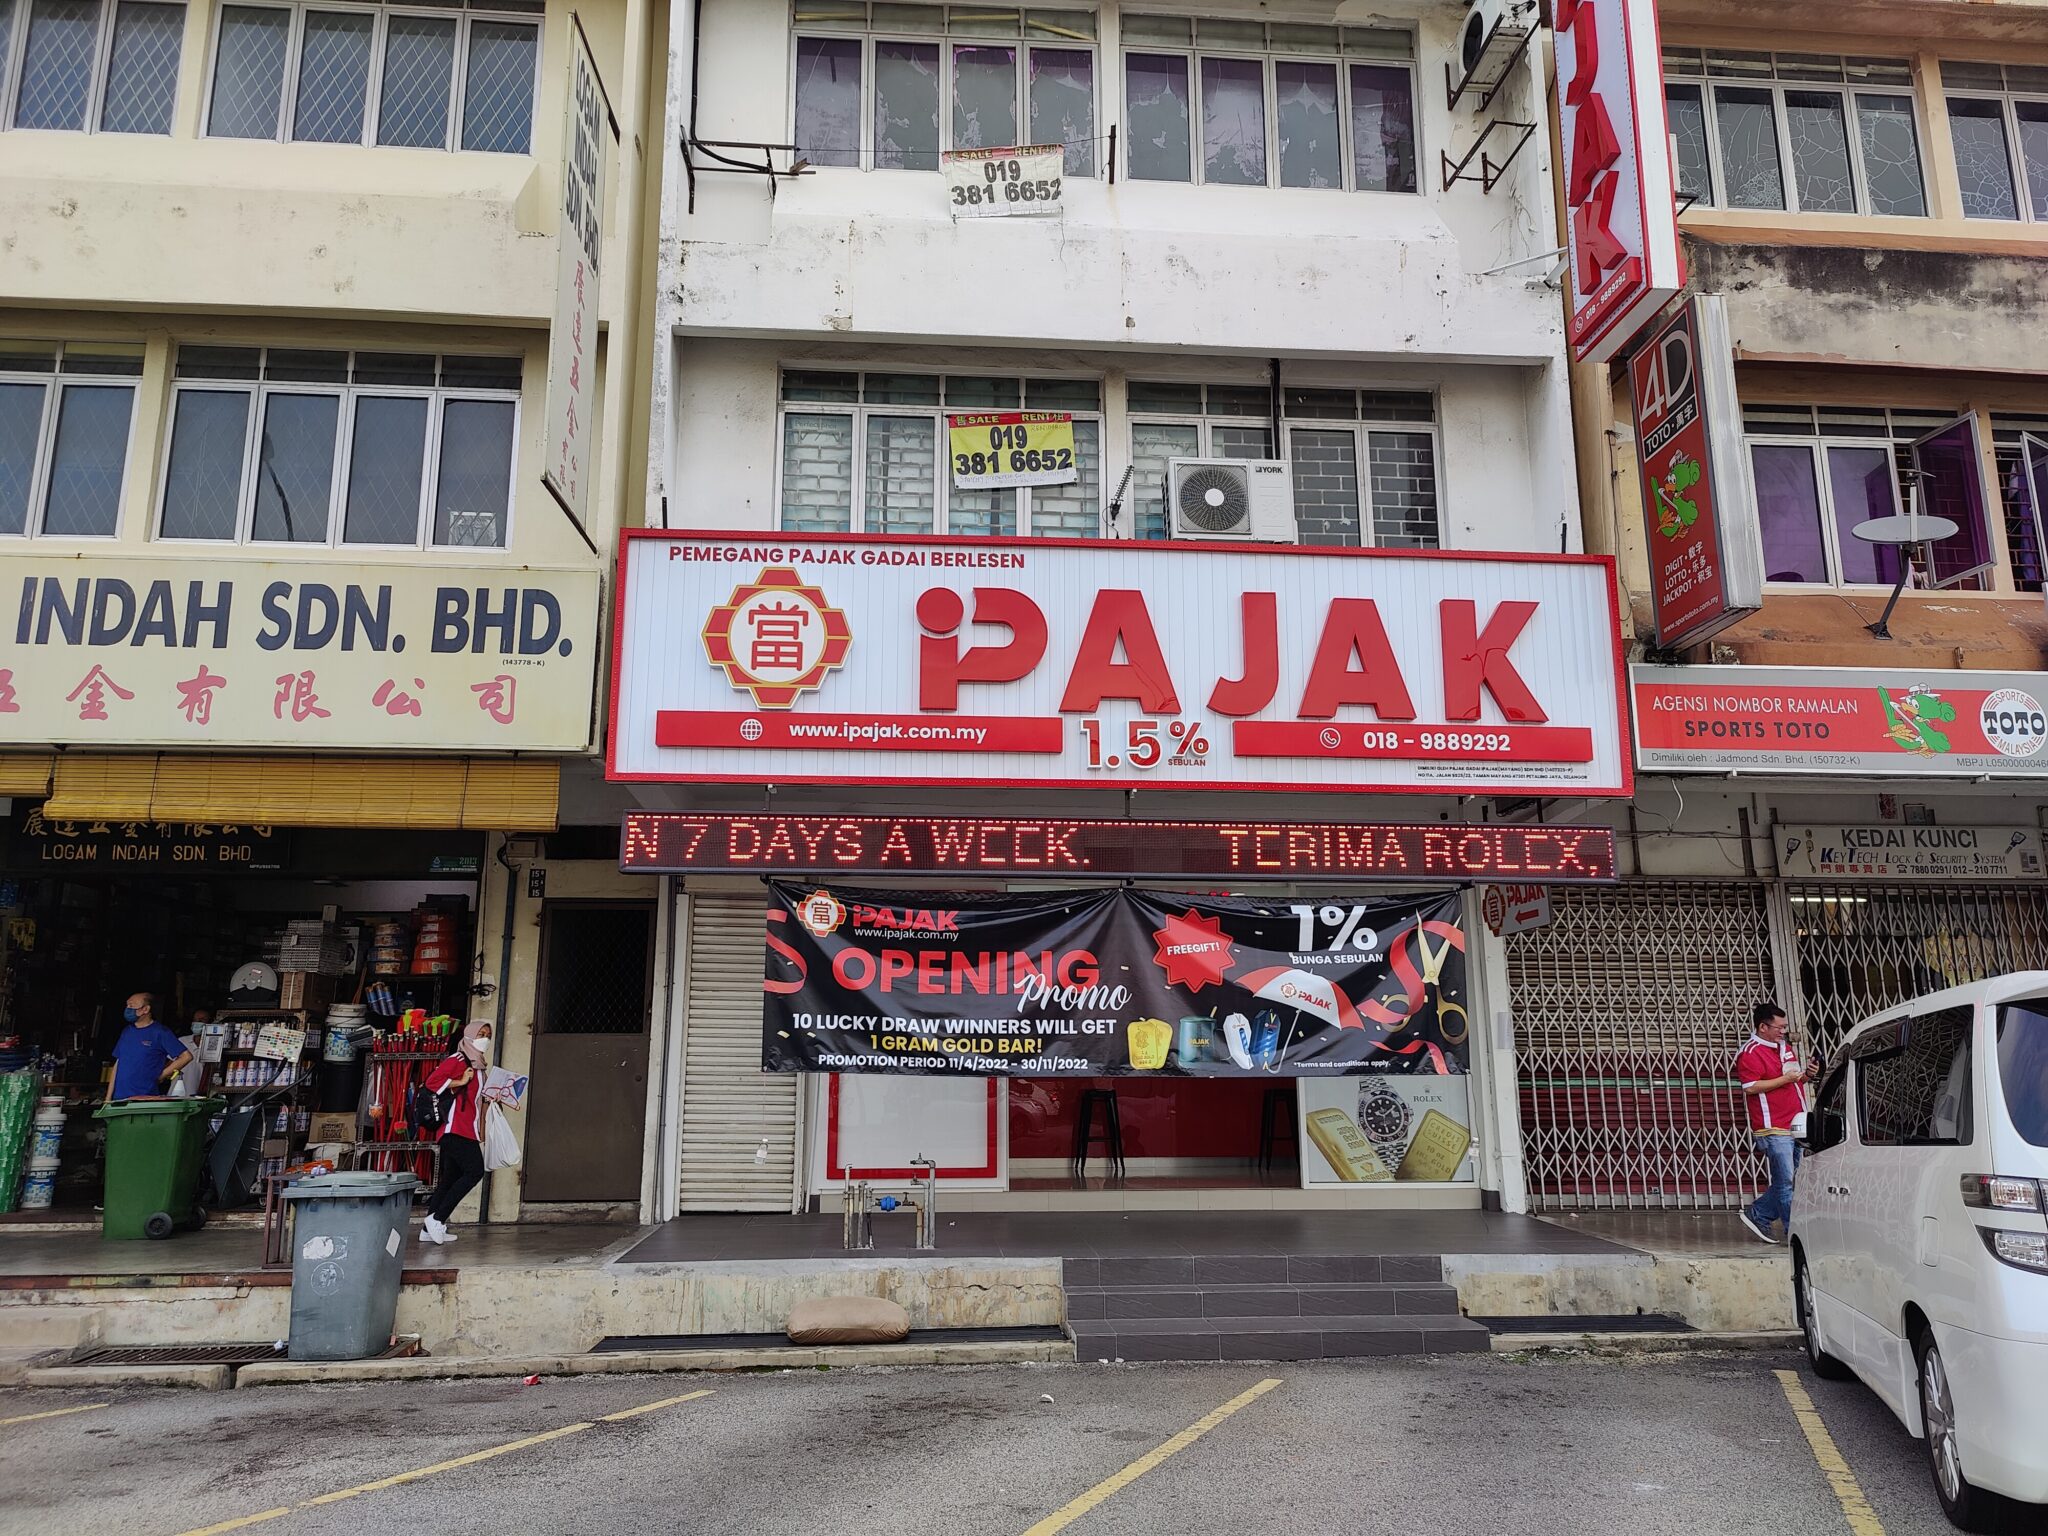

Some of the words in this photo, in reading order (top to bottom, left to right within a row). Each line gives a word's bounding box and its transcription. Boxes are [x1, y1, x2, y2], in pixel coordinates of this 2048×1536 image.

[575, 48, 600, 153] LOGAM
[574, 112, 598, 207] INDAH
[962, 149, 993, 160] SALE
[1014, 146, 1042, 157] RENT
[984, 160, 1020, 183] 019
[951, 184, 995, 206] 381
[1005, 178, 1061, 202] 6652
[1640, 330, 1693, 422] 4D
[968, 415, 999, 425] SALE
[1021, 413, 1052, 422] RENT
[990, 425, 1028, 450] 019
[1646, 423, 1671, 453] TOTO
[955, 452, 1000, 476] 381
[1010, 448, 1073, 473] 6652
[669, 546, 784, 563] PEMEGANG
[789, 548, 855, 565] PAJAK
[861, 550, 926, 566] GADAI
[931, 551, 1025, 569] BERLESEN
[1665, 555, 1684, 576] DIGIT
[1664, 568, 1687, 590] LOTTO
[1663, 579, 1692, 606] JACKPOT
[15, 576, 234, 649] INDAH
[255, 580, 407, 653] SDN.
[431, 587, 573, 658] BHD.
[1652, 695, 1708, 712] AGENSI
[1714, 697, 1783, 713] NOMBOR
[1788, 698, 1858, 715] RAMALAN
[1996, 690, 2026, 704] SPORTS
[789, 722, 987, 745] www.ipajak.com.my
[1685, 721, 1764, 738] SPORTS
[1773, 722, 1830, 739] TOTO
[1983, 711, 2046, 736] TOTO
[1080, 719, 1211, 772] 1.5%
[1363, 731, 1399, 749] 018
[1421, 731, 1511, 752] 9889292
[1997, 738, 2039, 756] MALAYSIA
[1168, 758, 1206, 767] SEBULAN
[1652, 753, 1685, 762] Dimiliki
[1687, 754, 1707, 763] oleh
[1716, 754, 1759, 763] Jadmond
[1761, 754, 1783, 764] Sdn.
[1785, 755, 1807, 764] Bhd.
[1809, 754, 1861, 765] (150732-K)
[1957, 758, 1983, 767] MBPJ
[1986, 758, 2048, 768] L0500000046
[682, 824, 707, 859] 7
[729, 823, 863, 861] DAYS
[881, 825, 912, 862] A
[1841, 829, 1906, 848] KEDAI
[1914, 830, 1978, 848] KUNCI
[42, 844, 97, 861] LOGAM
[112, 845, 159, 861] INDAH
[173, 845, 208, 861] SDN.
[532, 889, 540, 897] 15
[855, 928, 959, 941] www.ipajak.com.my
[1290, 905, 1378, 951] 1%
[1166, 942, 1220, 956] FREEGIFT!
[1292, 955, 1332, 965] BUNGA
[1334, 953, 1383, 963] SEBULAN
[832, 947, 1100, 995] OPENING
[1013, 973, 1132, 1013] Promo
[793, 1013, 814, 1029] 10
[816, 1014, 880, 1031] LUCKY
[882, 1017, 941, 1034] DRAW
[944, 1018, 1031, 1035] WINNERS
[1033, 1019, 1082, 1035] WILL
[1085, 1019, 1117, 1034] GET
[871, 1034, 878, 1050] 1
[883, 1035, 938, 1052] GRAM
[942, 1037, 995, 1054] GOLD
[998, 1037, 1042, 1054] BAR!
[818, 1054, 897, 1068] PROMOTION
[900, 1056, 946, 1068] PERIOD
[949, 1056, 1009, 1071] 11/4/2022
[1021, 1057, 1088, 1071] 30/11/2022
[1371, 1060, 1391, 1068] apply.
[1413, 1095, 1442, 1103] ROLEX
